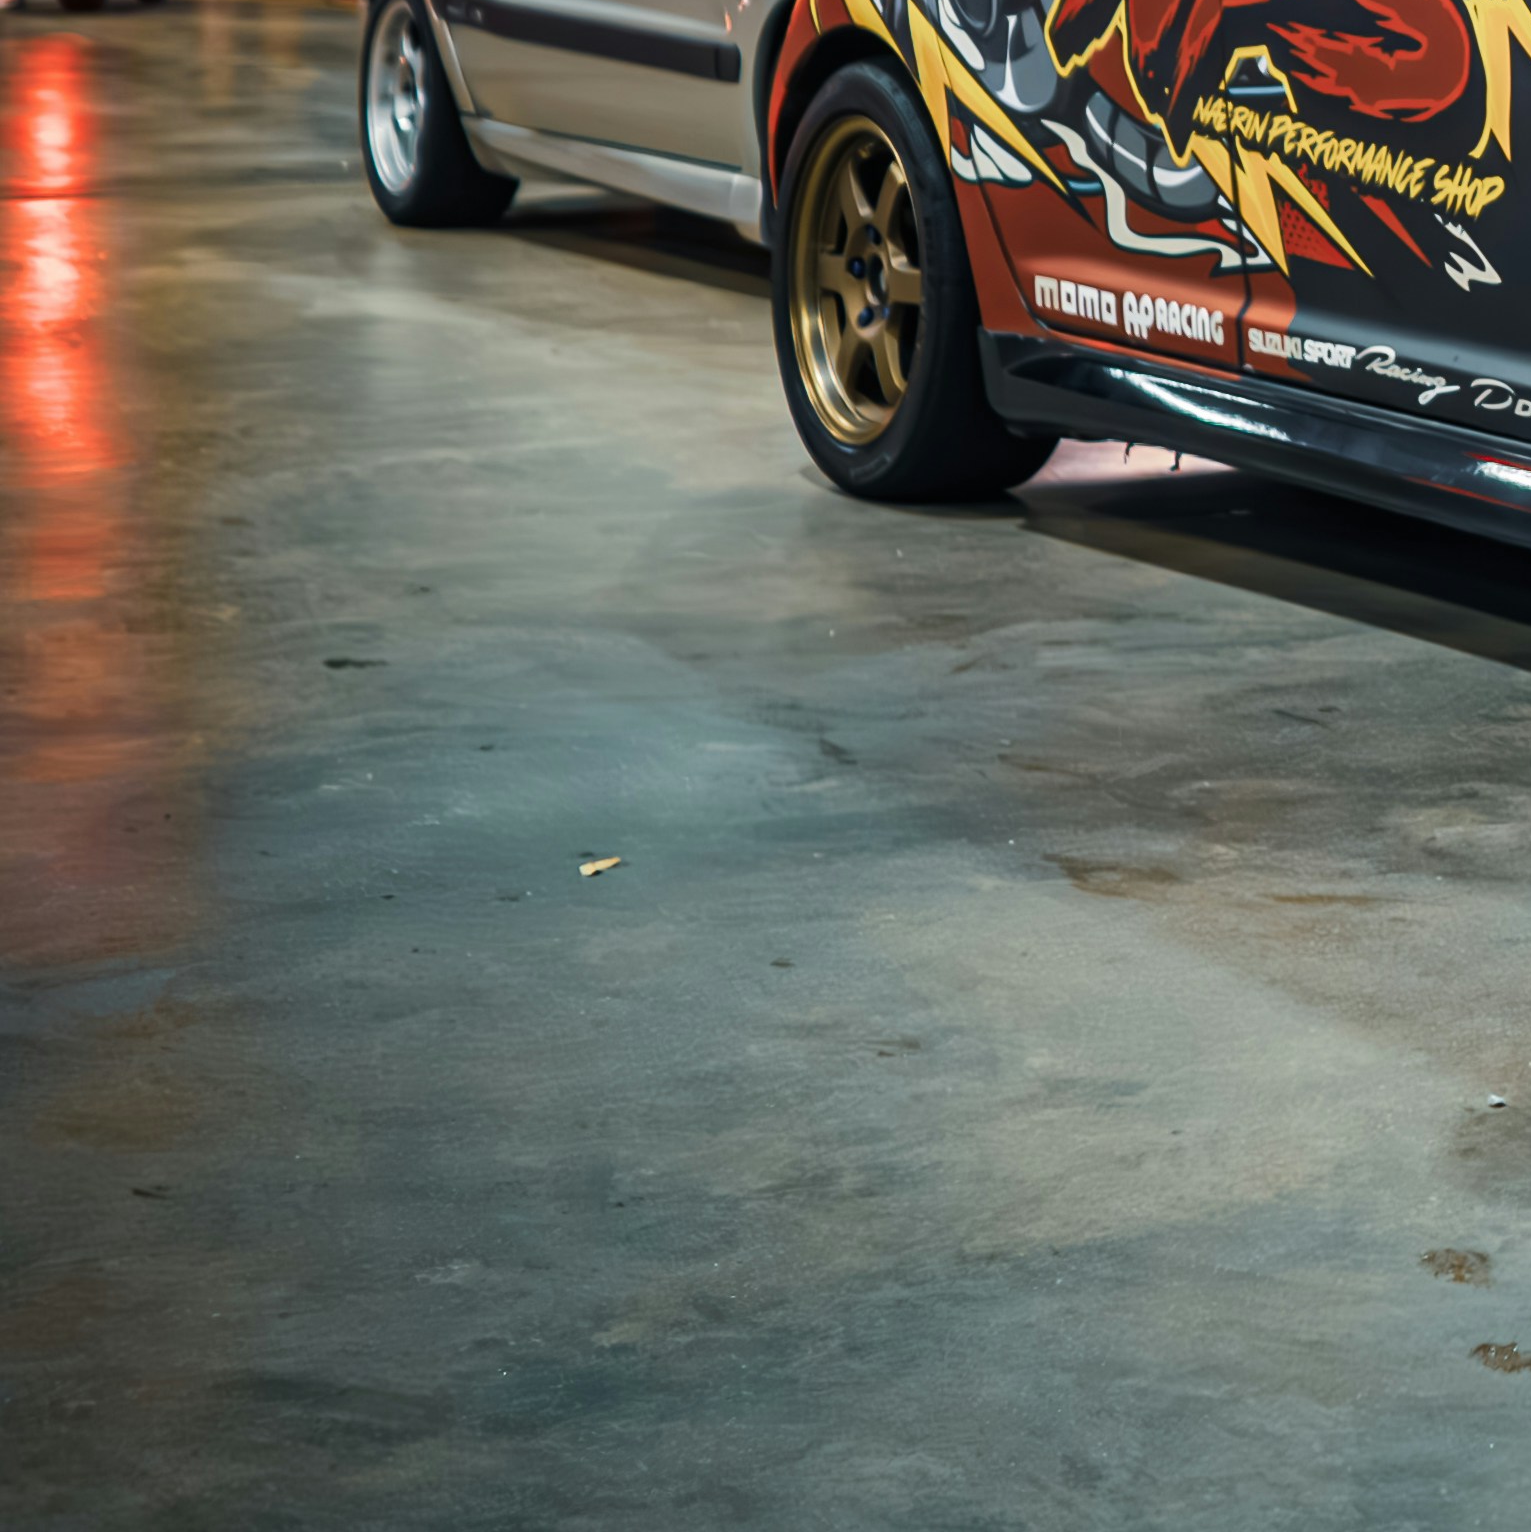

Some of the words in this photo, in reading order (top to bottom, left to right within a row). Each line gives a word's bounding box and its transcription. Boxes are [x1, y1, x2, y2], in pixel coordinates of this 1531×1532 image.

[1266, 113, 1436, 200] PERFORMANCE
[1430, 161, 1505, 221] SHOP
[1154, 297, 1225, 346] RACING
[1248, 328, 1302, 361] SUZUKI
[1303, 338, 1356, 369] SPORT
[1355, 344, 1461, 406] Racing
